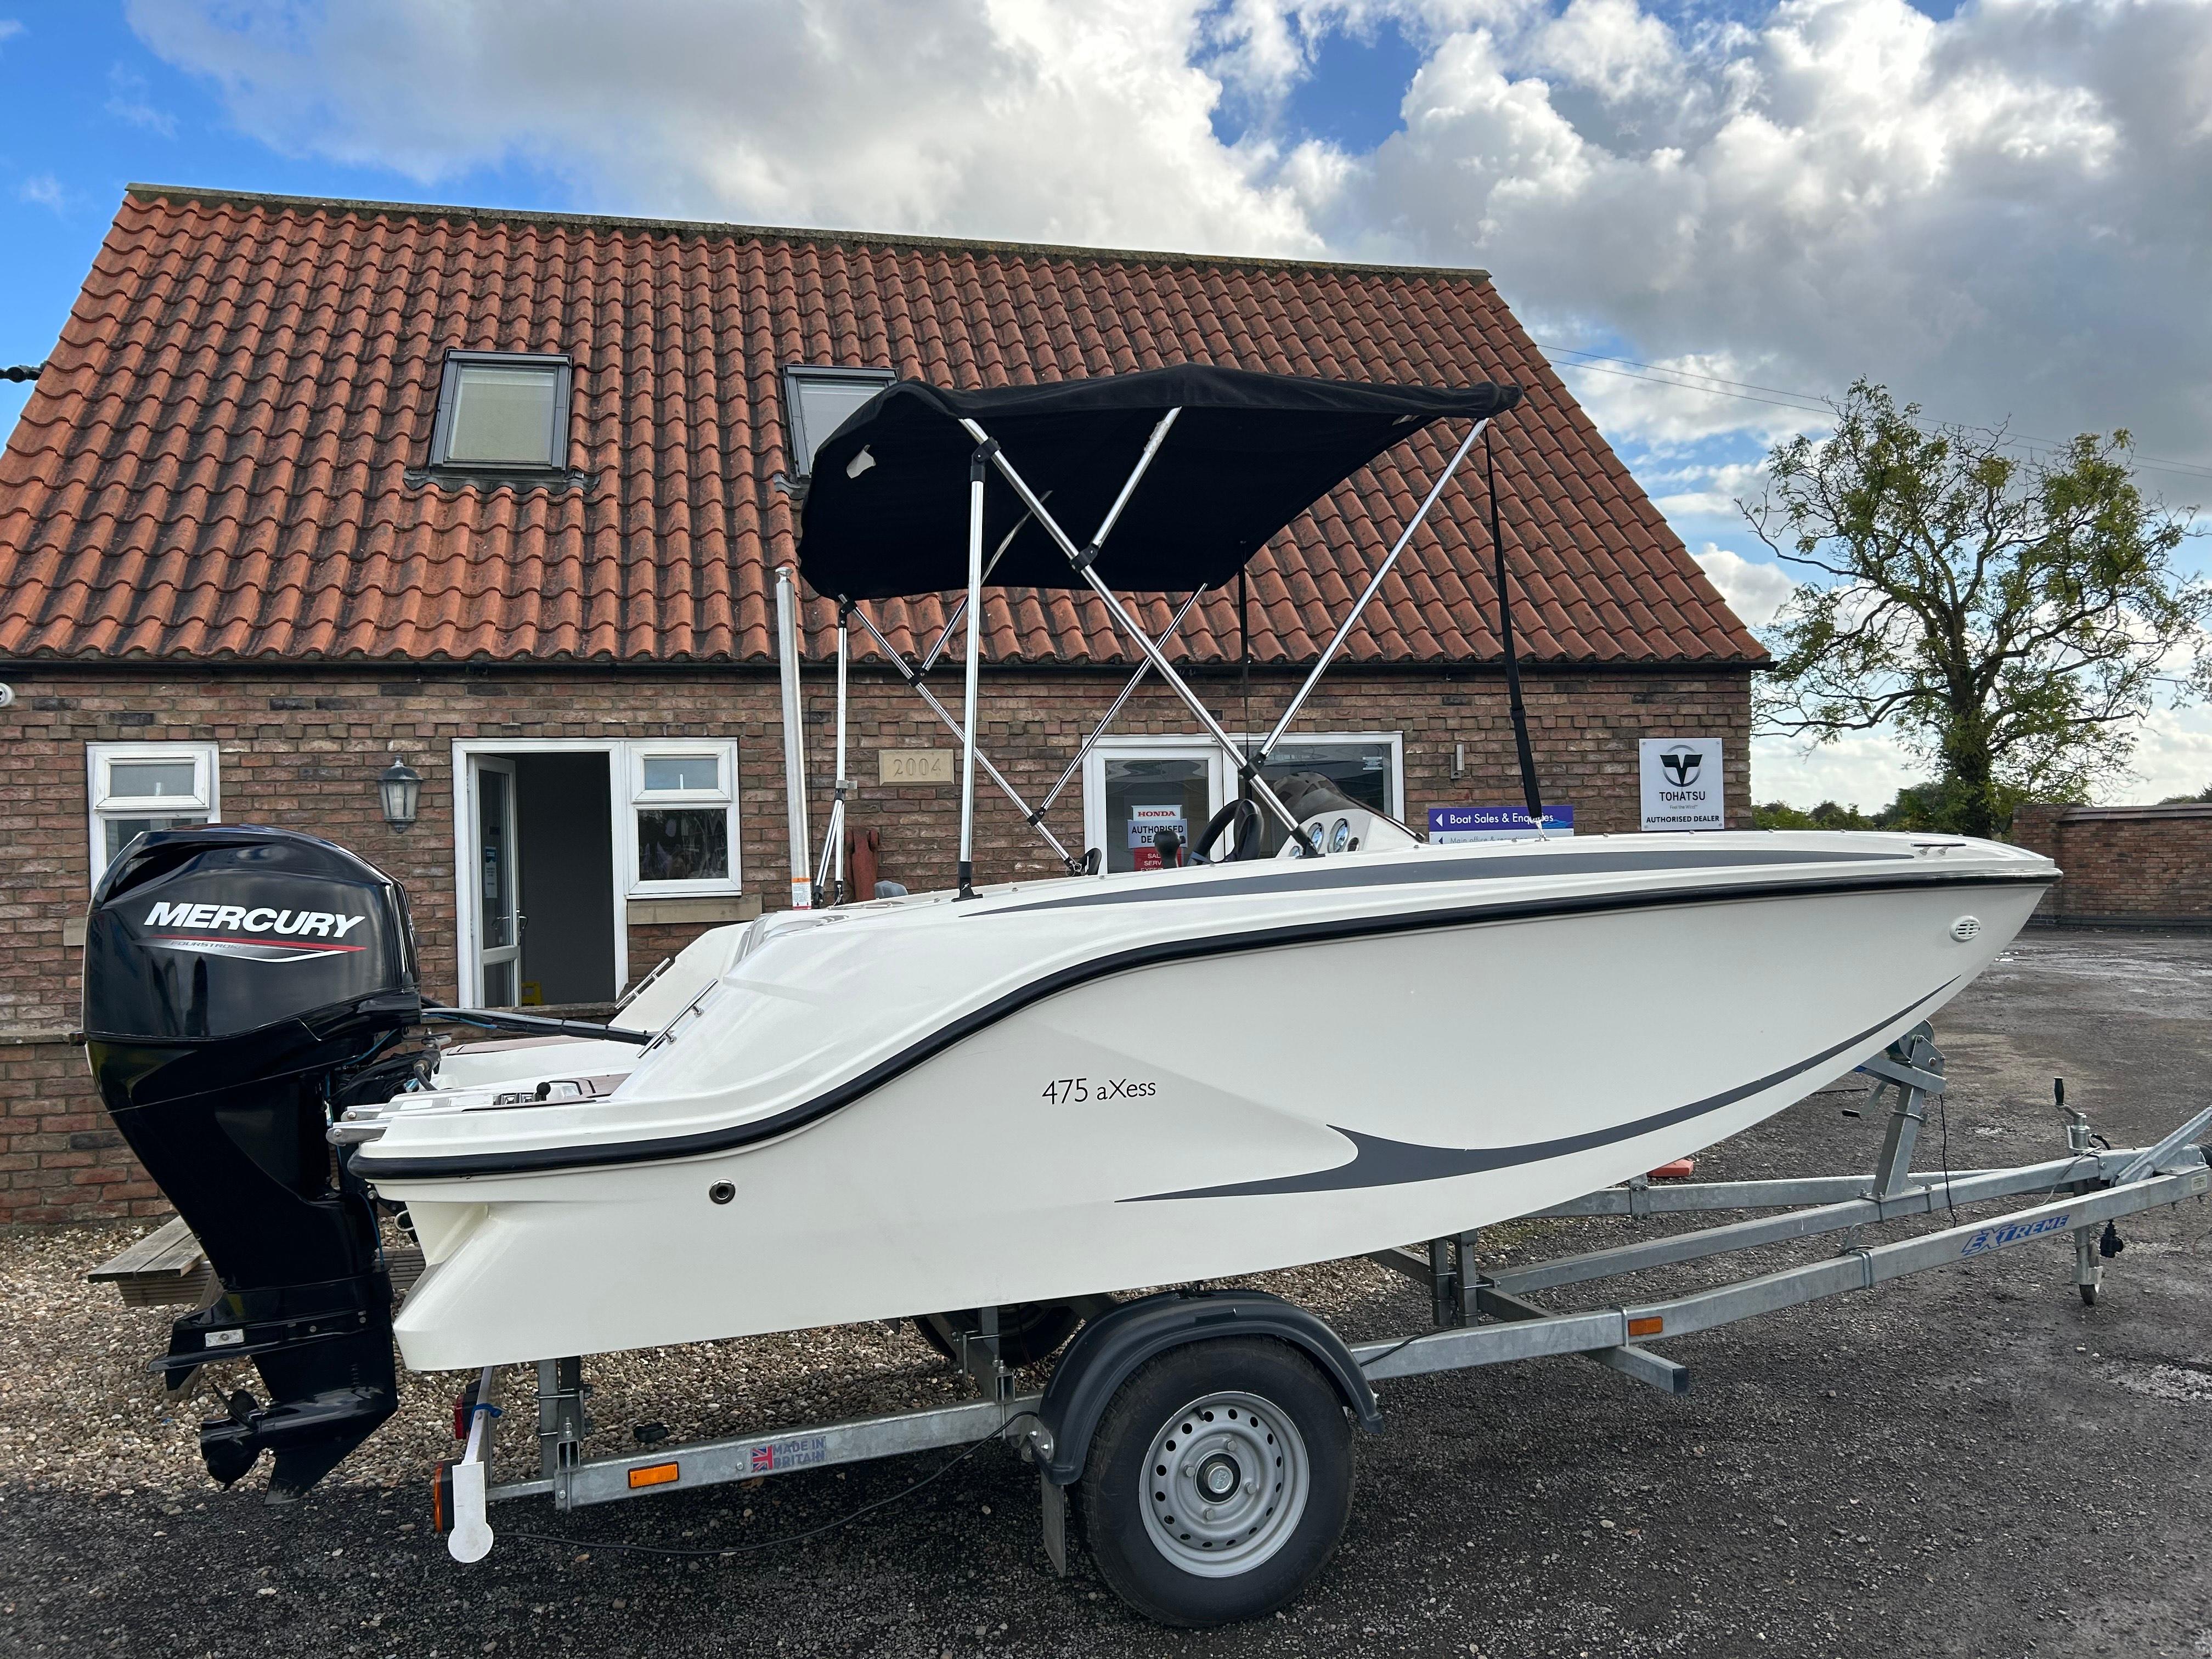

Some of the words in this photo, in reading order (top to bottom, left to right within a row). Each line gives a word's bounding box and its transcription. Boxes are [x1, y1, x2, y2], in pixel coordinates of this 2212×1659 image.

[893, 758, 941, 777] 2004
[1659, 791, 1706, 801] TOHATSU
[1450, 815, 1471, 824] Boat
[1474, 813, 1499, 823] Sales
[1502, 812, 1509, 822] &
[1513, 812, 1554, 825] Enqies
[1131, 825, 1183, 834] AUTHORISED
[144, 902, 365, 938] MERCURY
[171, 940, 247, 949] FOURSTROKE
[1042, 1078, 1088, 1105] 475
[1097, 1079, 1156, 1100] aXess
[1961, 1215, 2070, 1256] EXTREME
[773, 1440, 808, 1455] MADE
[812, 1438, 825, 1449] IN
[773, 1450, 825, 1469] BRITAIN
